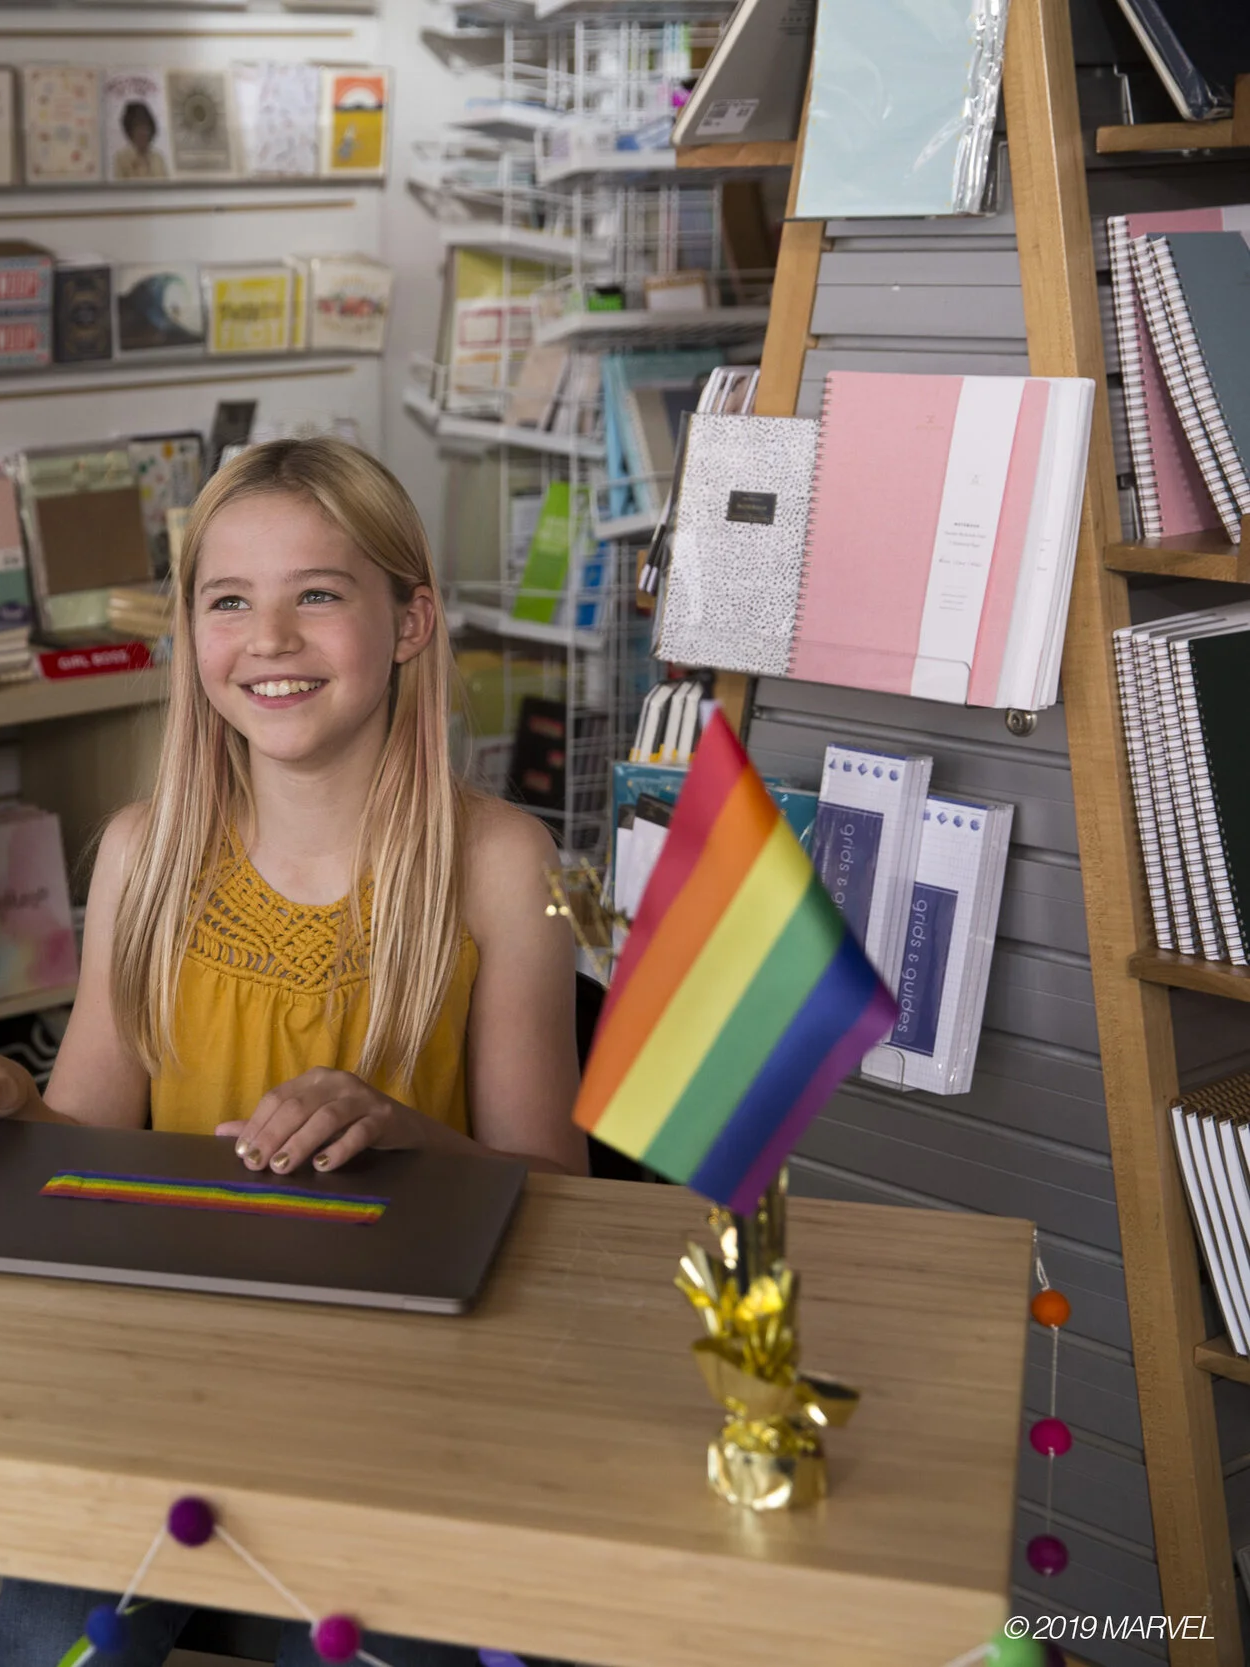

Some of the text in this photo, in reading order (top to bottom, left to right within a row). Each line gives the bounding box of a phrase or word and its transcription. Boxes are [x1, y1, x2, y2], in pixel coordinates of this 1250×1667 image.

[57, 653, 89, 671] GIRL
[839, 823, 856, 873] grids
[910, 899, 928, 949] grids
[897, 967, 918, 1034] guides
